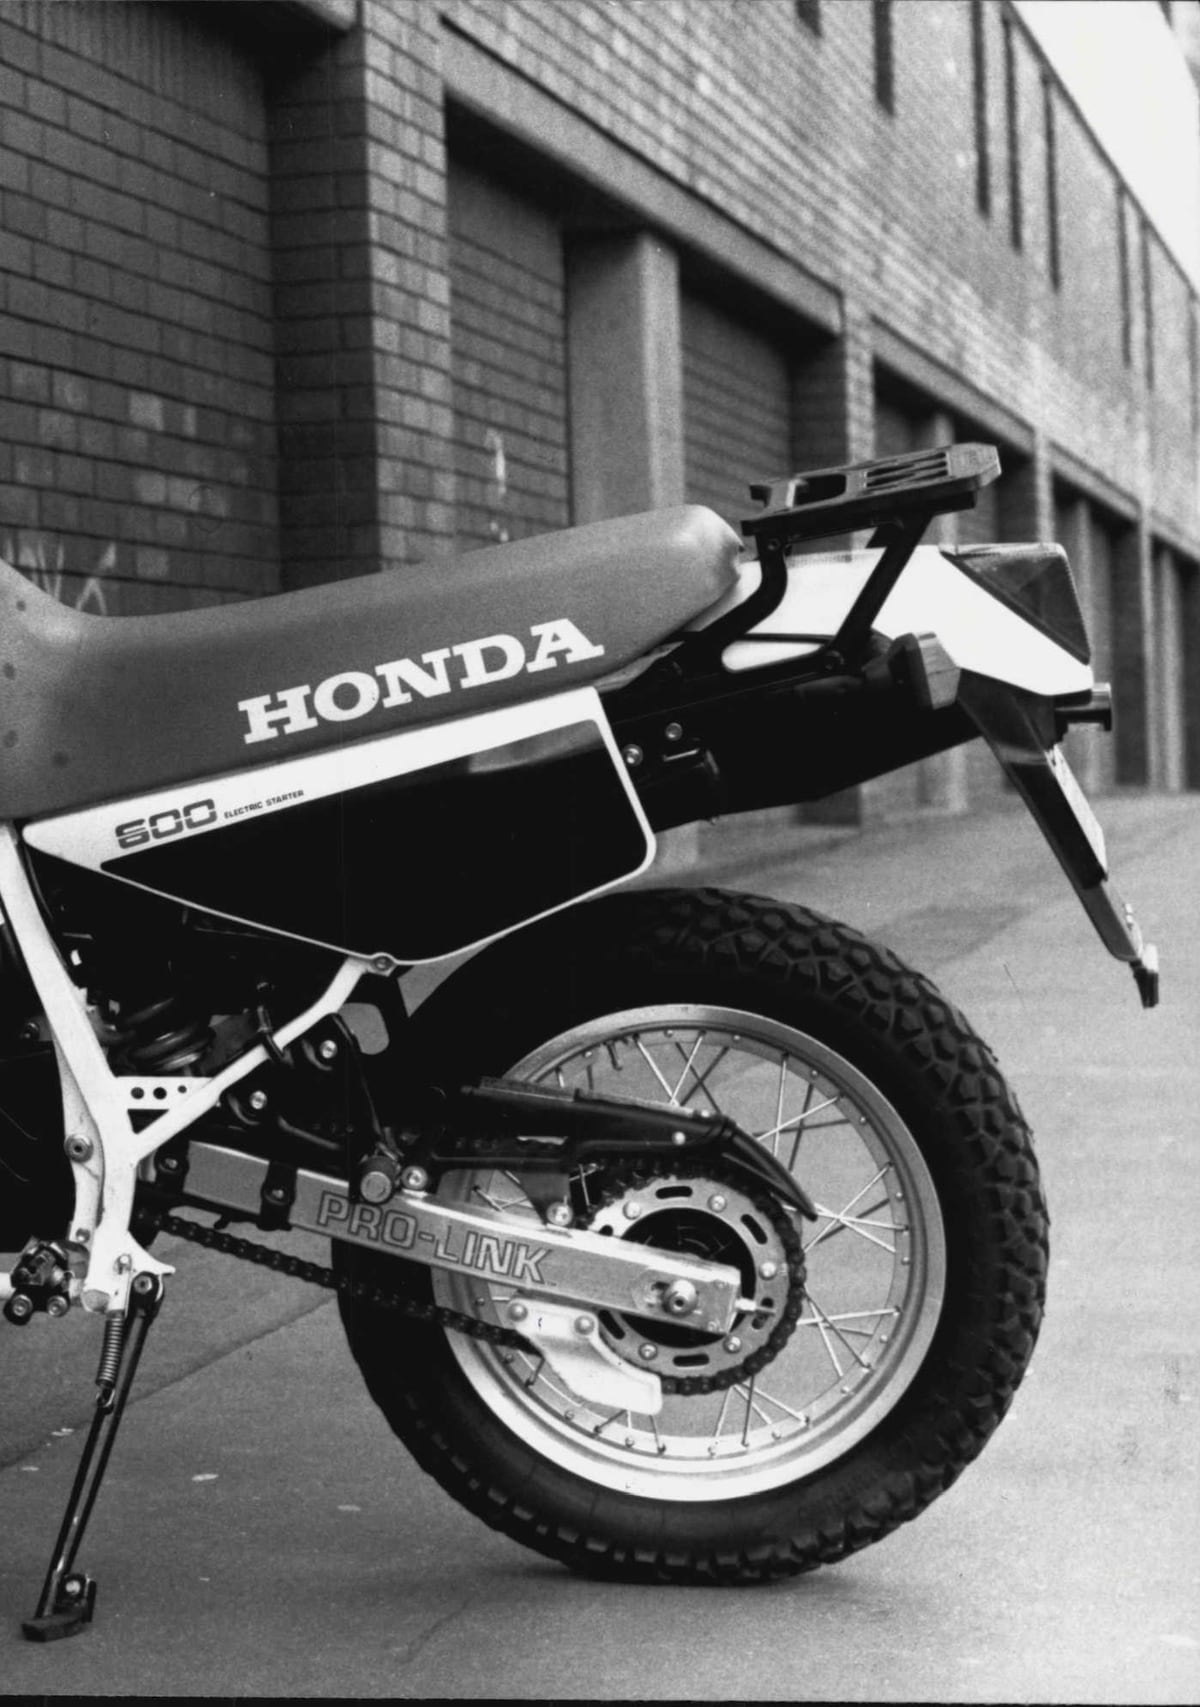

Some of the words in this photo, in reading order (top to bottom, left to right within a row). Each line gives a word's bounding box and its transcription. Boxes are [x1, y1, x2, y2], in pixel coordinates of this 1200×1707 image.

[237, 618, 605, 744] HONDA
[114, 798, 218, 850] 600
[224, 801, 263, 819] ELECTRIC
[265, 789, 305, 807] STARTER
[317, 1190, 552, 1285] PRO-LINK
